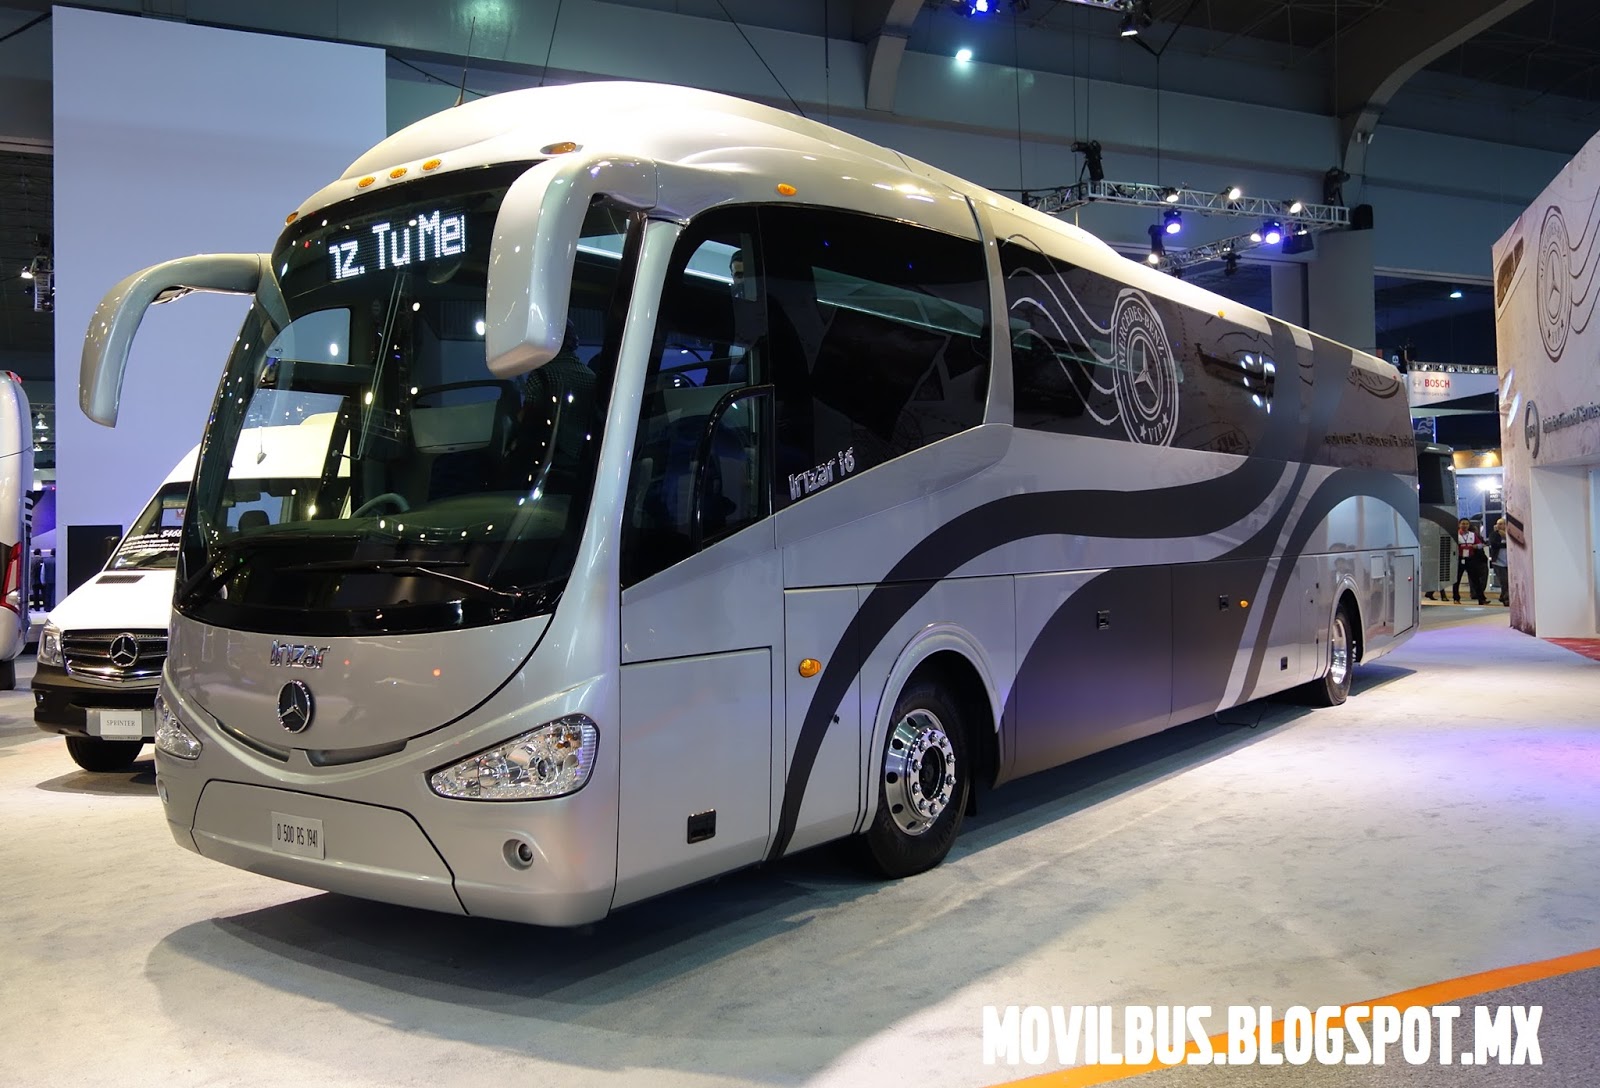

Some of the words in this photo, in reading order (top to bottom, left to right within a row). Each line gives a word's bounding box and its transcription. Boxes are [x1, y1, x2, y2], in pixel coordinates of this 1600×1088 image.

[1118, 305, 1165, 371] MERCEDES-BENZ
[1424, 378, 1450, 388] BOSCH
[1147, 422, 1163, 442] VIP
[838, 446, 855, 476] i6
[106, 719, 136, 727] SPRINTER
[283, 824, 295, 843] 500
[296, 826, 304, 846] RS
[306, 828, 318, 848] 1941
